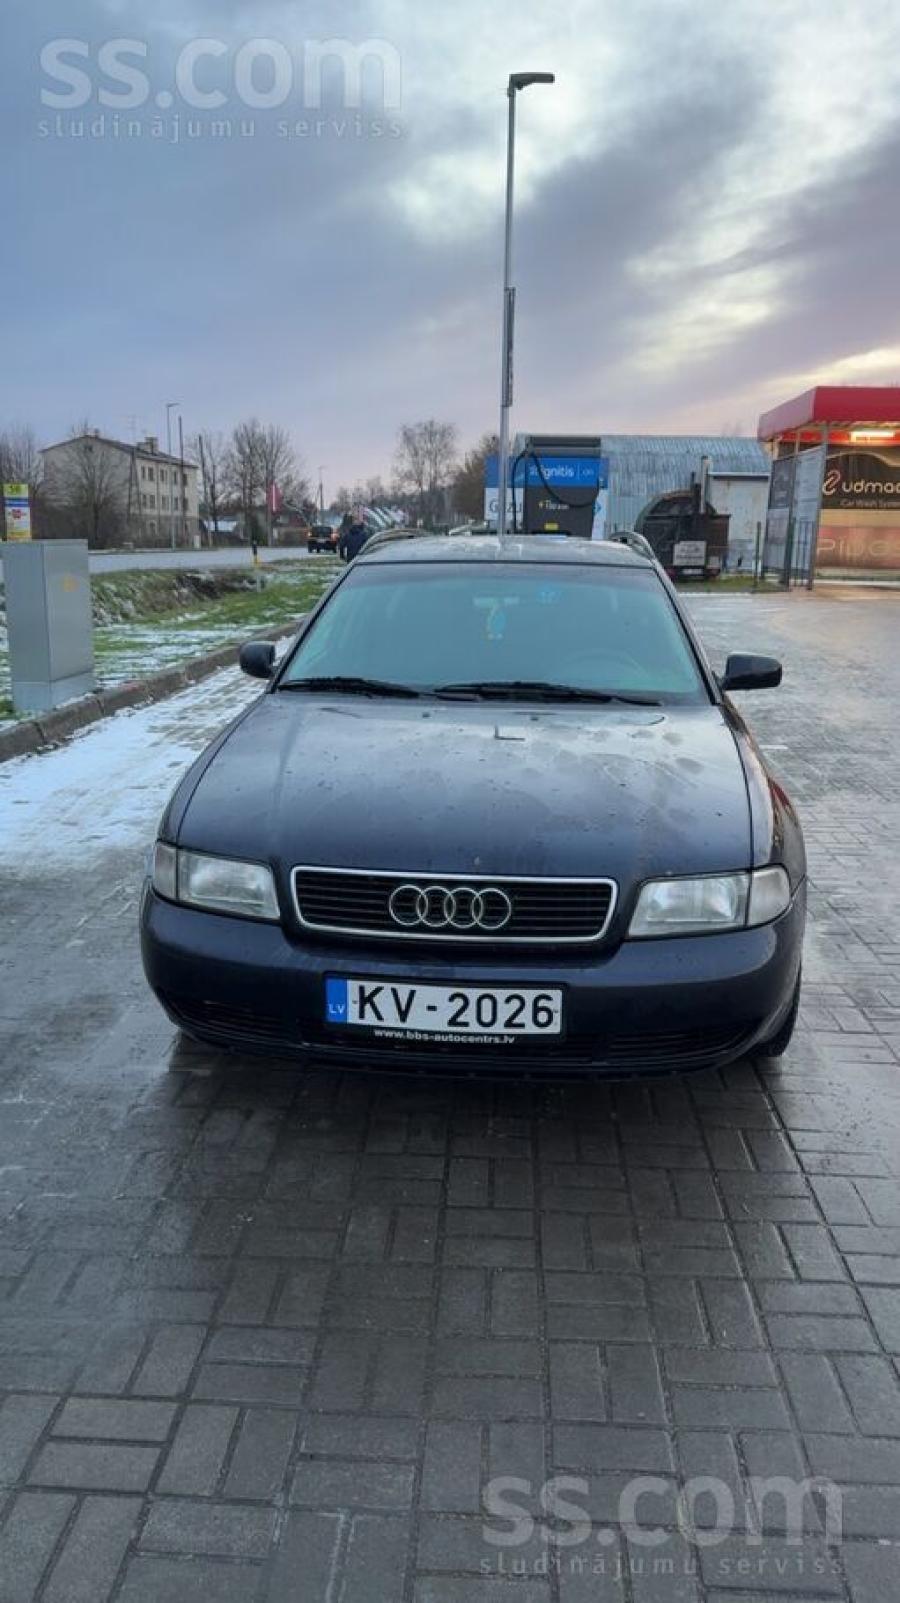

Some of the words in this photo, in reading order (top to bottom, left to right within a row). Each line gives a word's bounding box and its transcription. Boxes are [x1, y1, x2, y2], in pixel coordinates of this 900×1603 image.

[328, 1003, 345, 1014] LV
[358, 985, 555, 1029] KV-2026
[374, 1028, 516, 1044] www.bbs-autocentrs.lv
